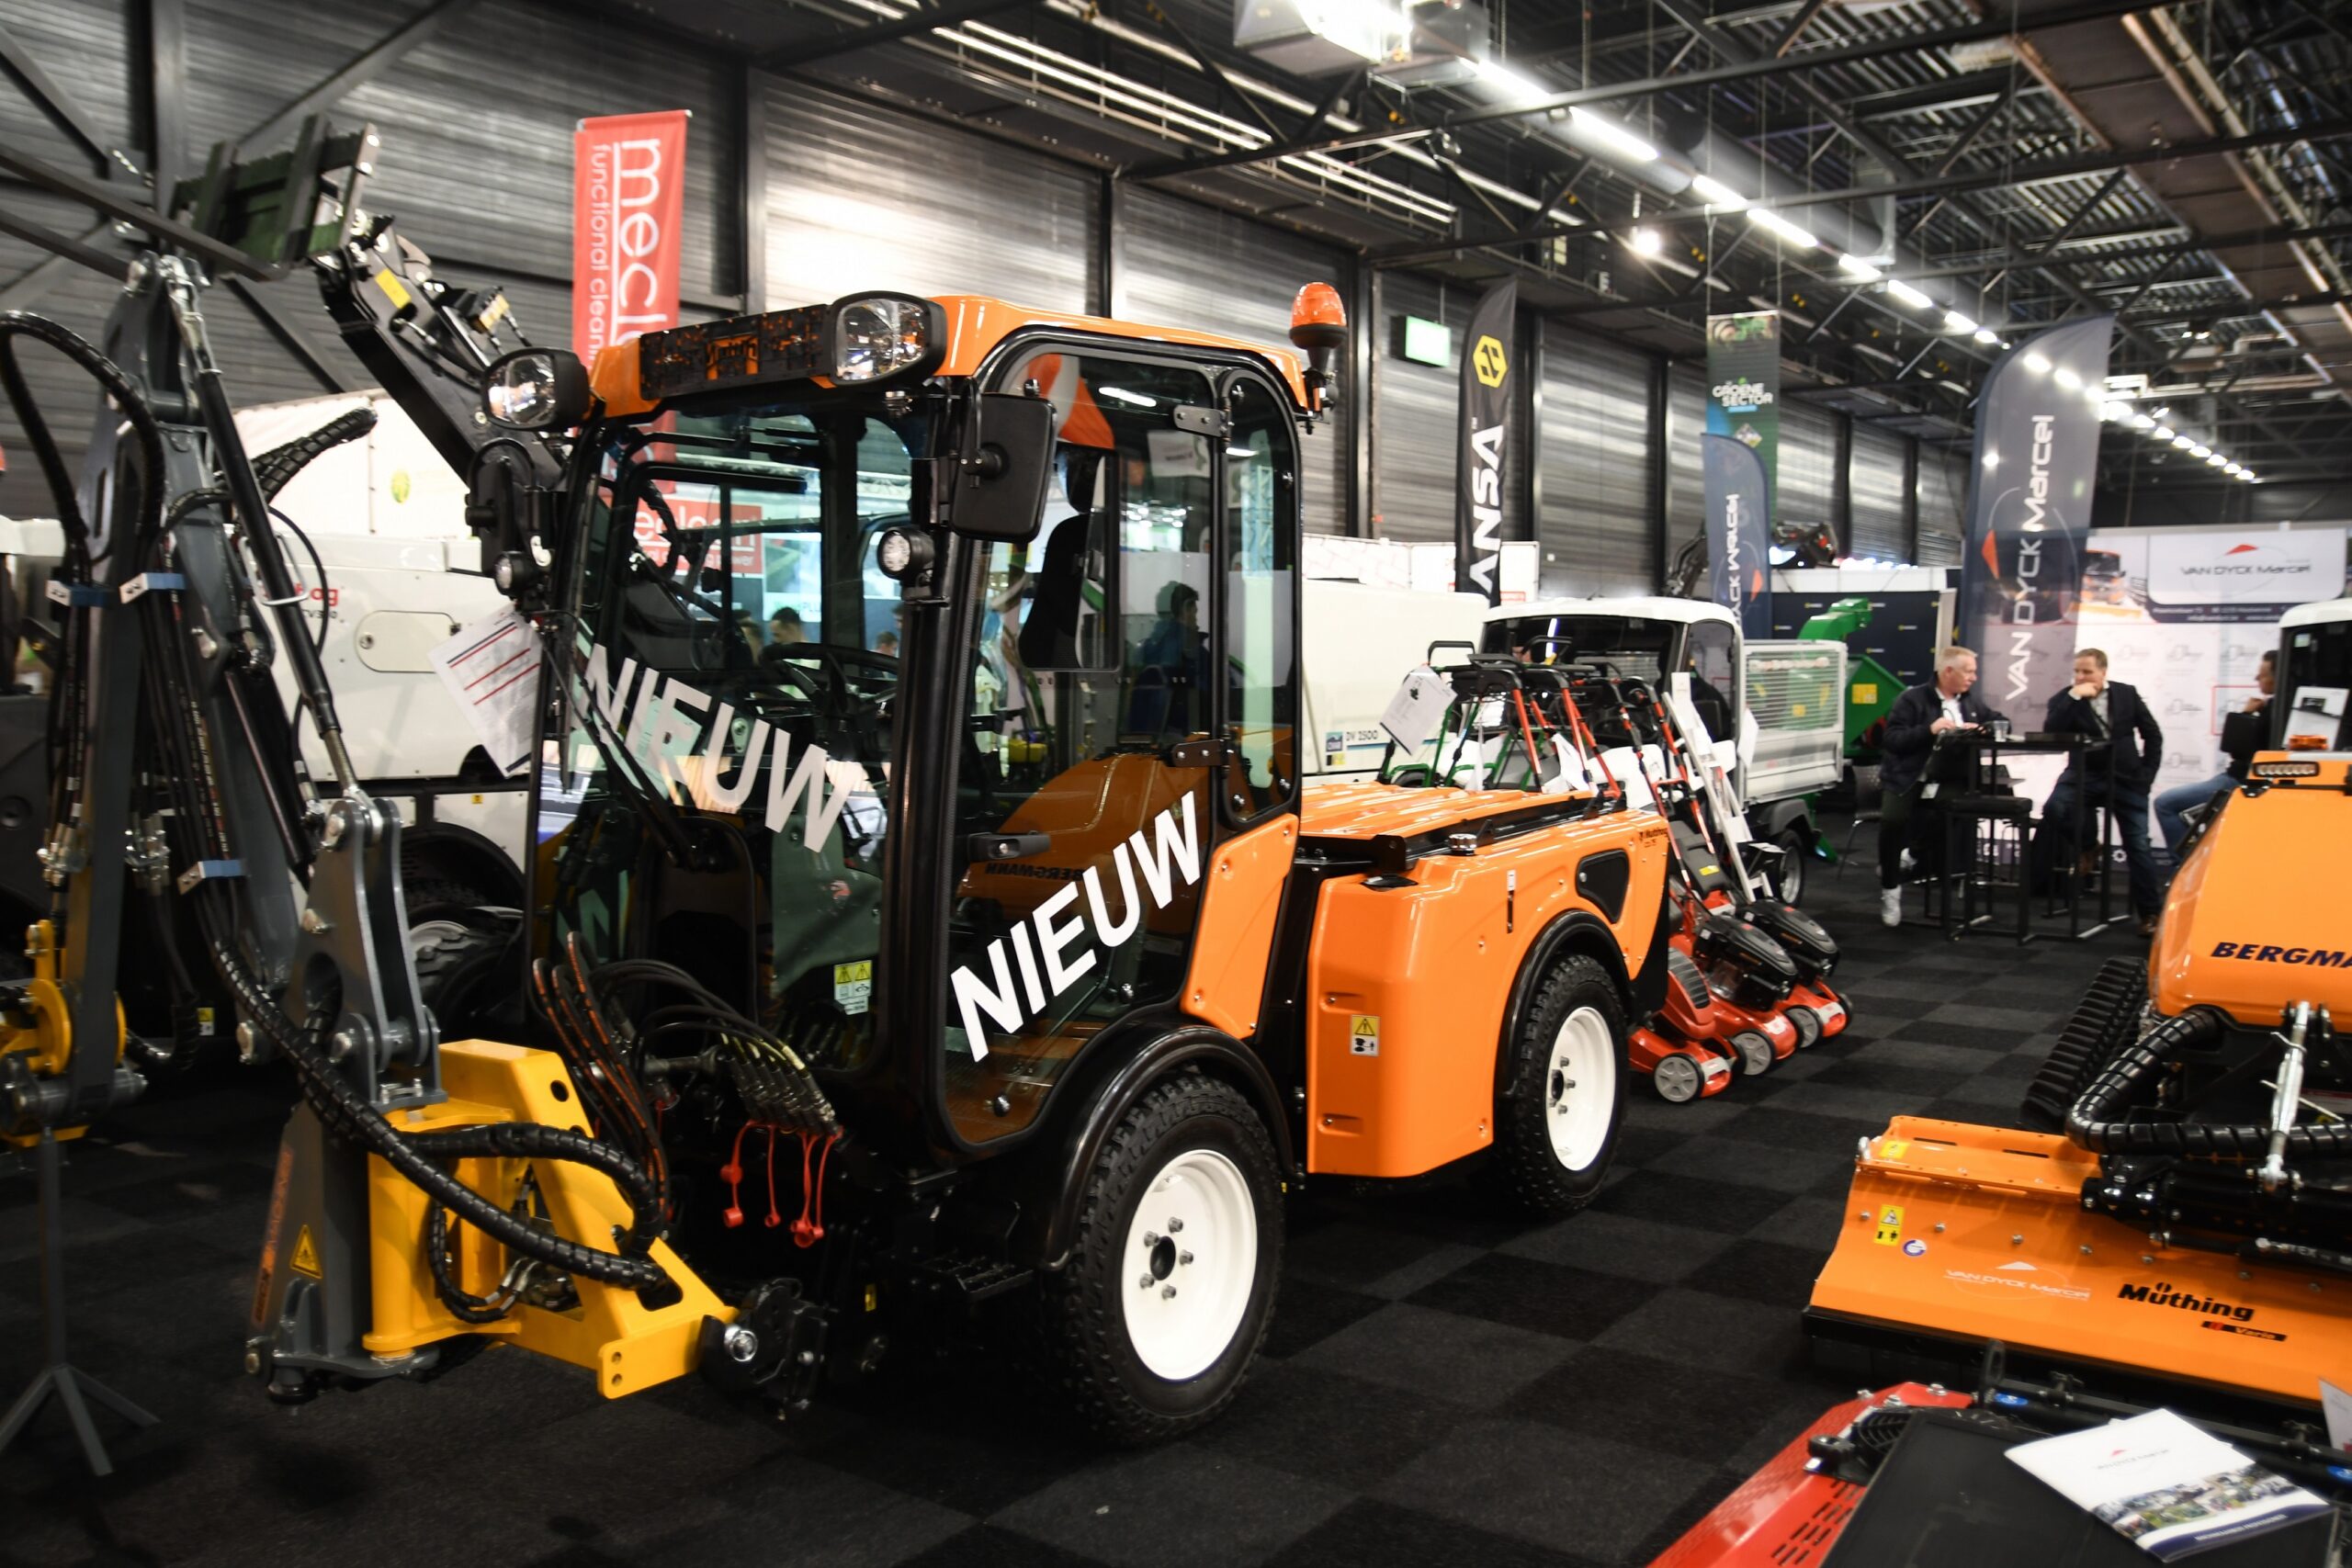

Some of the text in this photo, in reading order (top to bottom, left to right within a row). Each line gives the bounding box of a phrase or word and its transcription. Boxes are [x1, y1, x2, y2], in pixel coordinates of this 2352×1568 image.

[589, 144, 613, 271] functional
[2006, 414, 2054, 701] VAN DYCK Marcel
[2181, 567, 2211, 575] VAN
[571, 643, 862, 853] NIEUW
[951, 791, 1202, 1063] NIEUW
[1945, 1269, 1981, 1281] VAN
